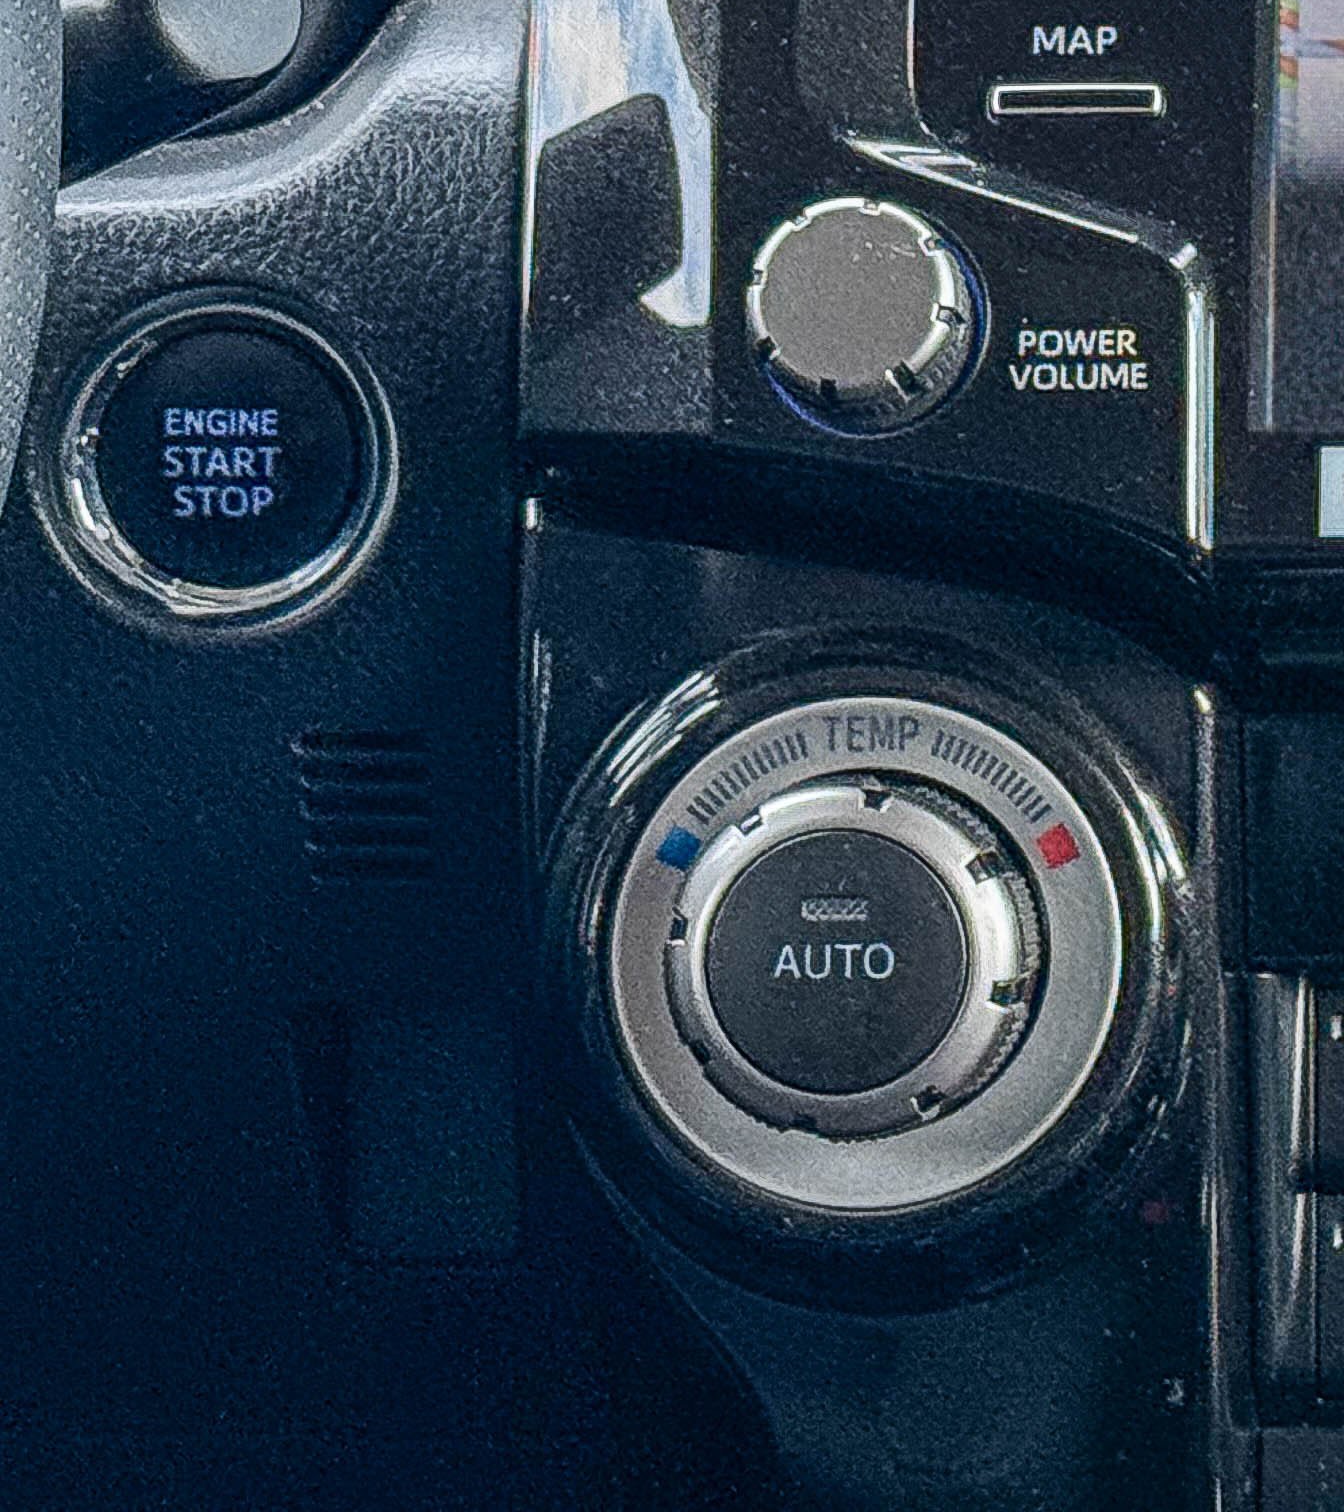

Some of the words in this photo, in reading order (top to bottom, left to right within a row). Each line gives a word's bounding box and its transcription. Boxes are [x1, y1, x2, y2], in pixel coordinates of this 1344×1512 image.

[1032, 25, 1119, 56] MAP
[1018, 330, 1137, 357] POWER
[1009, 363, 1149, 391] VOLUME
[163, 408, 279, 437] ENGINE
[163, 446, 282, 478] START
[173, 486, 275, 518] STOP
[822, 716, 919, 752] TEMP
[773, 942, 896, 981] AUTO
